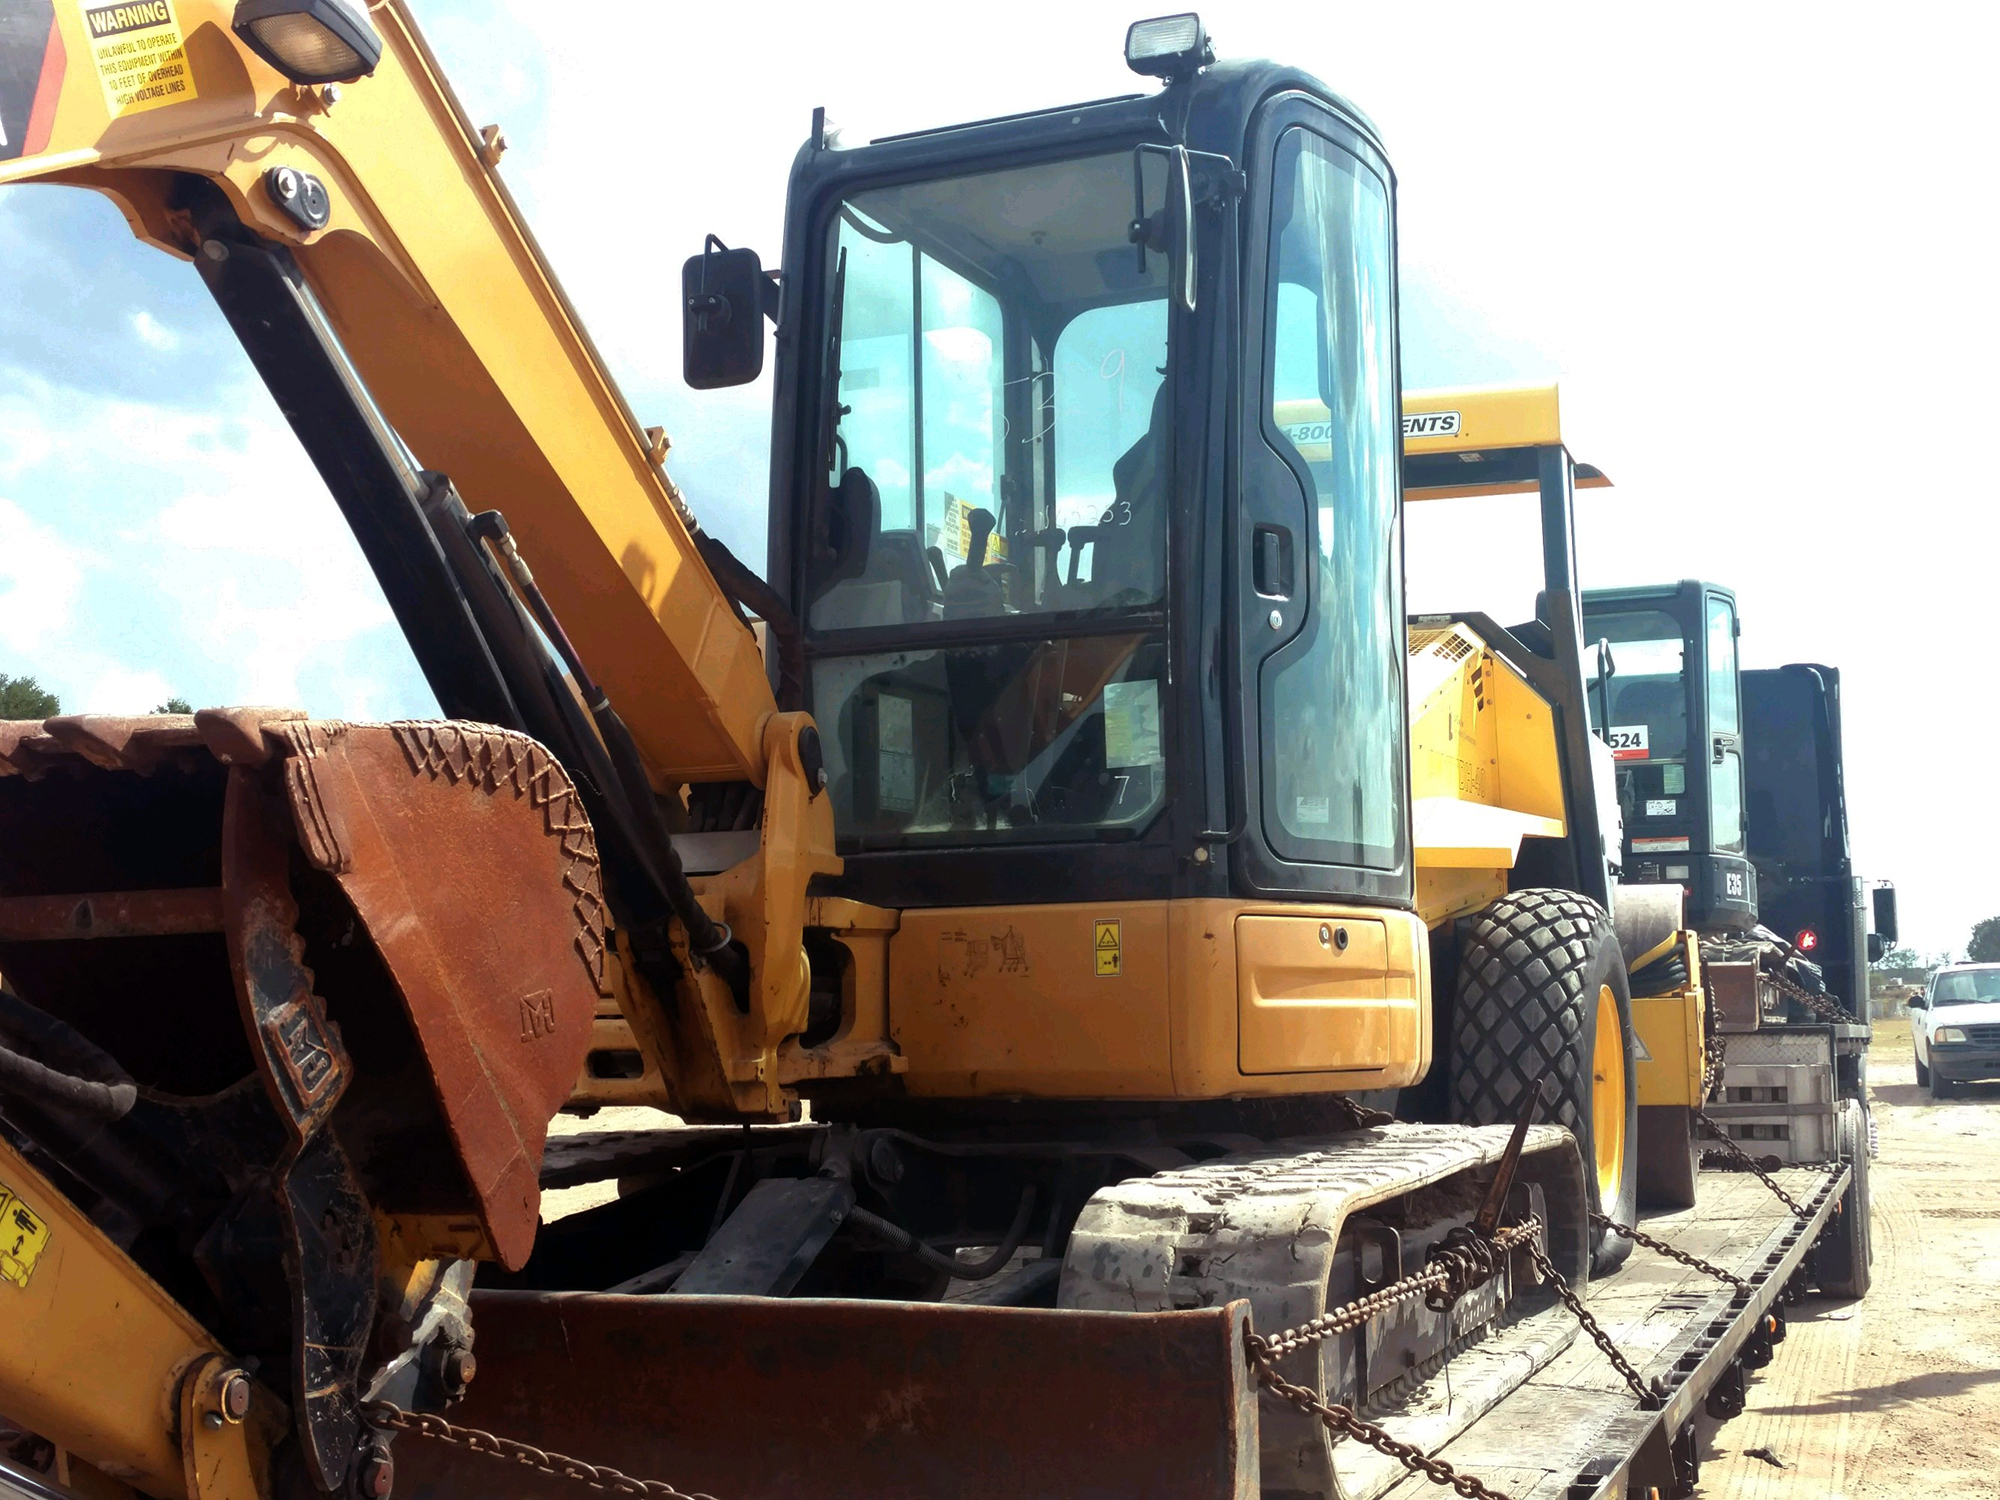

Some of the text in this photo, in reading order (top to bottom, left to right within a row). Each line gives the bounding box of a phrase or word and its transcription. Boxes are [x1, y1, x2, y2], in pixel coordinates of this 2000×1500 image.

[90, 1, 168, 34] WARNING
[97, 33, 178, 60] UNLAWFUL TO OPERATE
[100, 48, 184, 76] THIS EQUIPMENT WITHIN
[109, 64, 184, 90] 10 FEET OF OVERHEAD
[116, 80, 185, 106] HIGH VOLTAGE LINES
[1610, 732, 1642, 749] 524
[1726, 872, 1742, 896] E35
